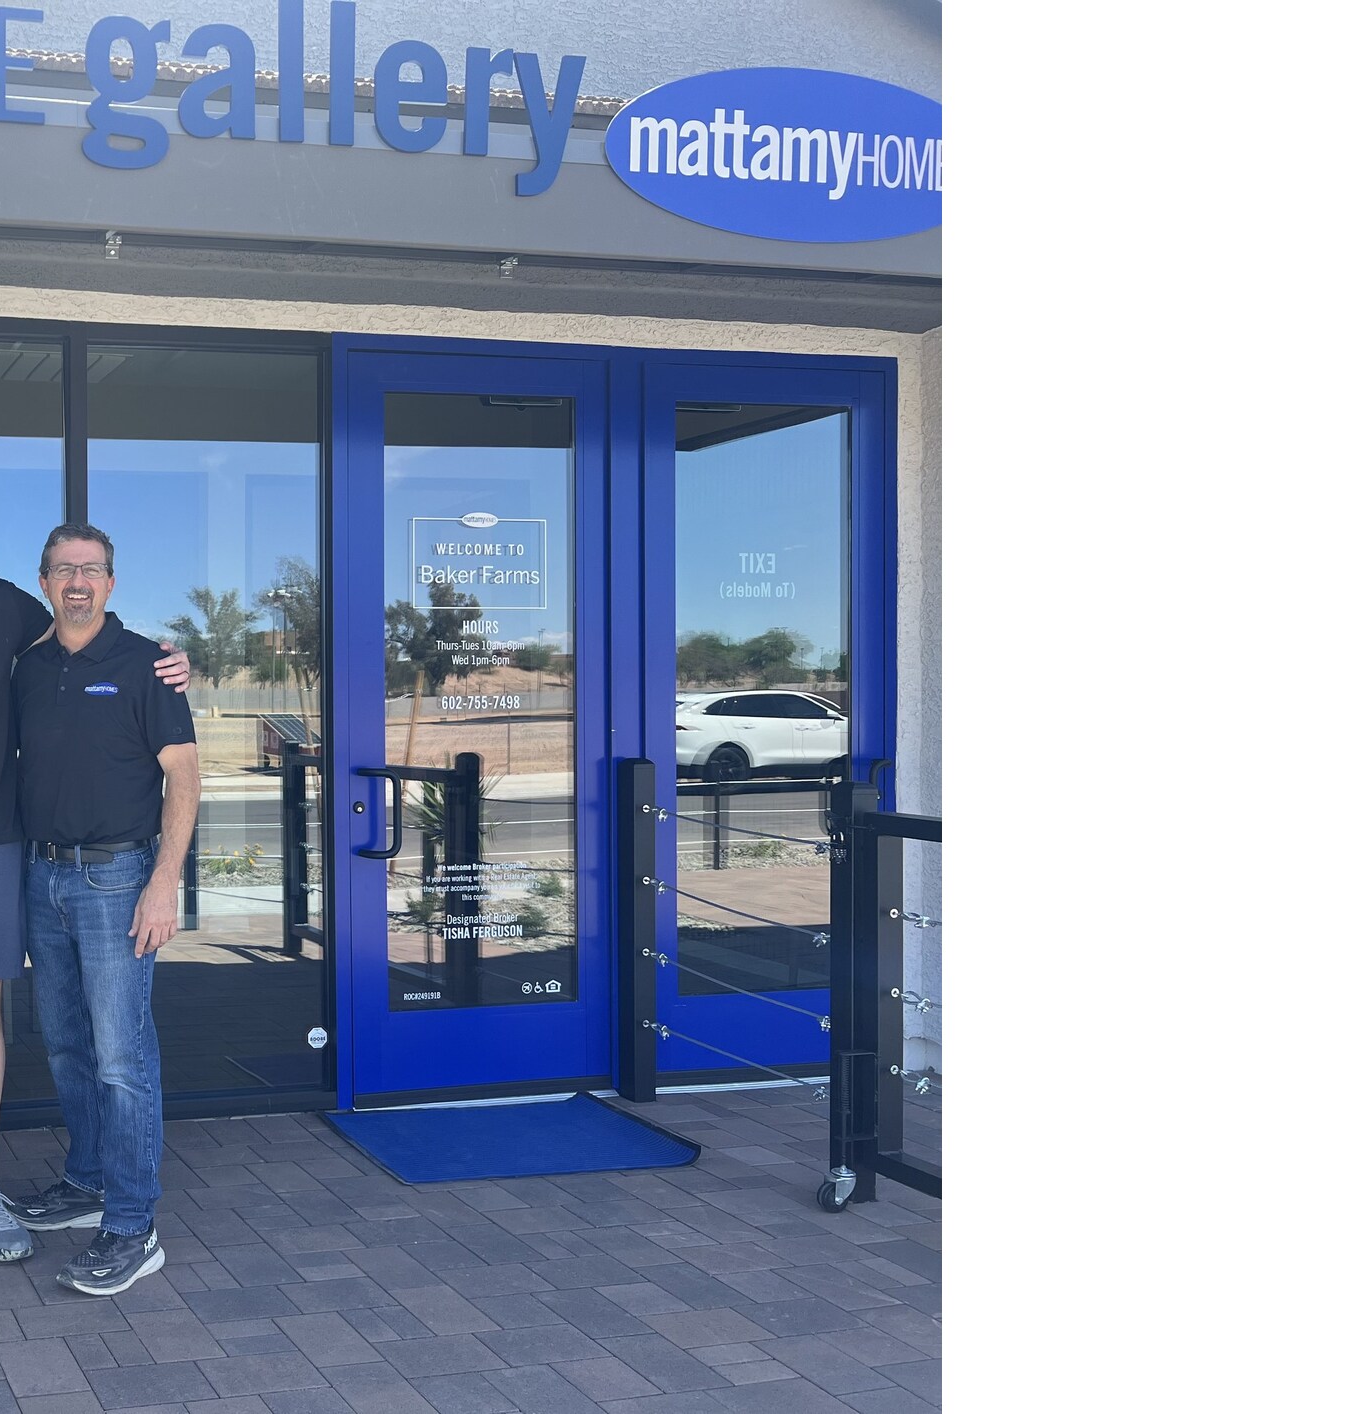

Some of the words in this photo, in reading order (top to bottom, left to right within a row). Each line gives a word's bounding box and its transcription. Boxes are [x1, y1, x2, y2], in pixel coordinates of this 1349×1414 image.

[81, 0, 587, 197] gallery
[436, 543, 502, 556] WELCOME
[508, 543, 524, 556] TO
[421, 564, 477, 584] Baker
[482, 565, 540, 585] Farms
[462, 620, 499, 634] HOURS
[436, 640, 480, 651] Thurs-Tues
[481, 640, 525, 652] 10am-6pm
[451, 655, 469, 665] Wed
[471, 654, 510, 667] 1pm-6pm
[441, 695, 520, 709] 602-755-7498
[472, 863, 492, 871] Broker
[451, 874, 473, 883] working
[423, 885, 435, 893] they
[450, 884, 480, 893] accompany
[461, 893, 473, 901] this
[447, 913, 491, 926] Designated
[493, 911, 519, 923] Broker
[442, 927, 470, 940] TISHA
[473, 925, 523, 938] FERGUSON
